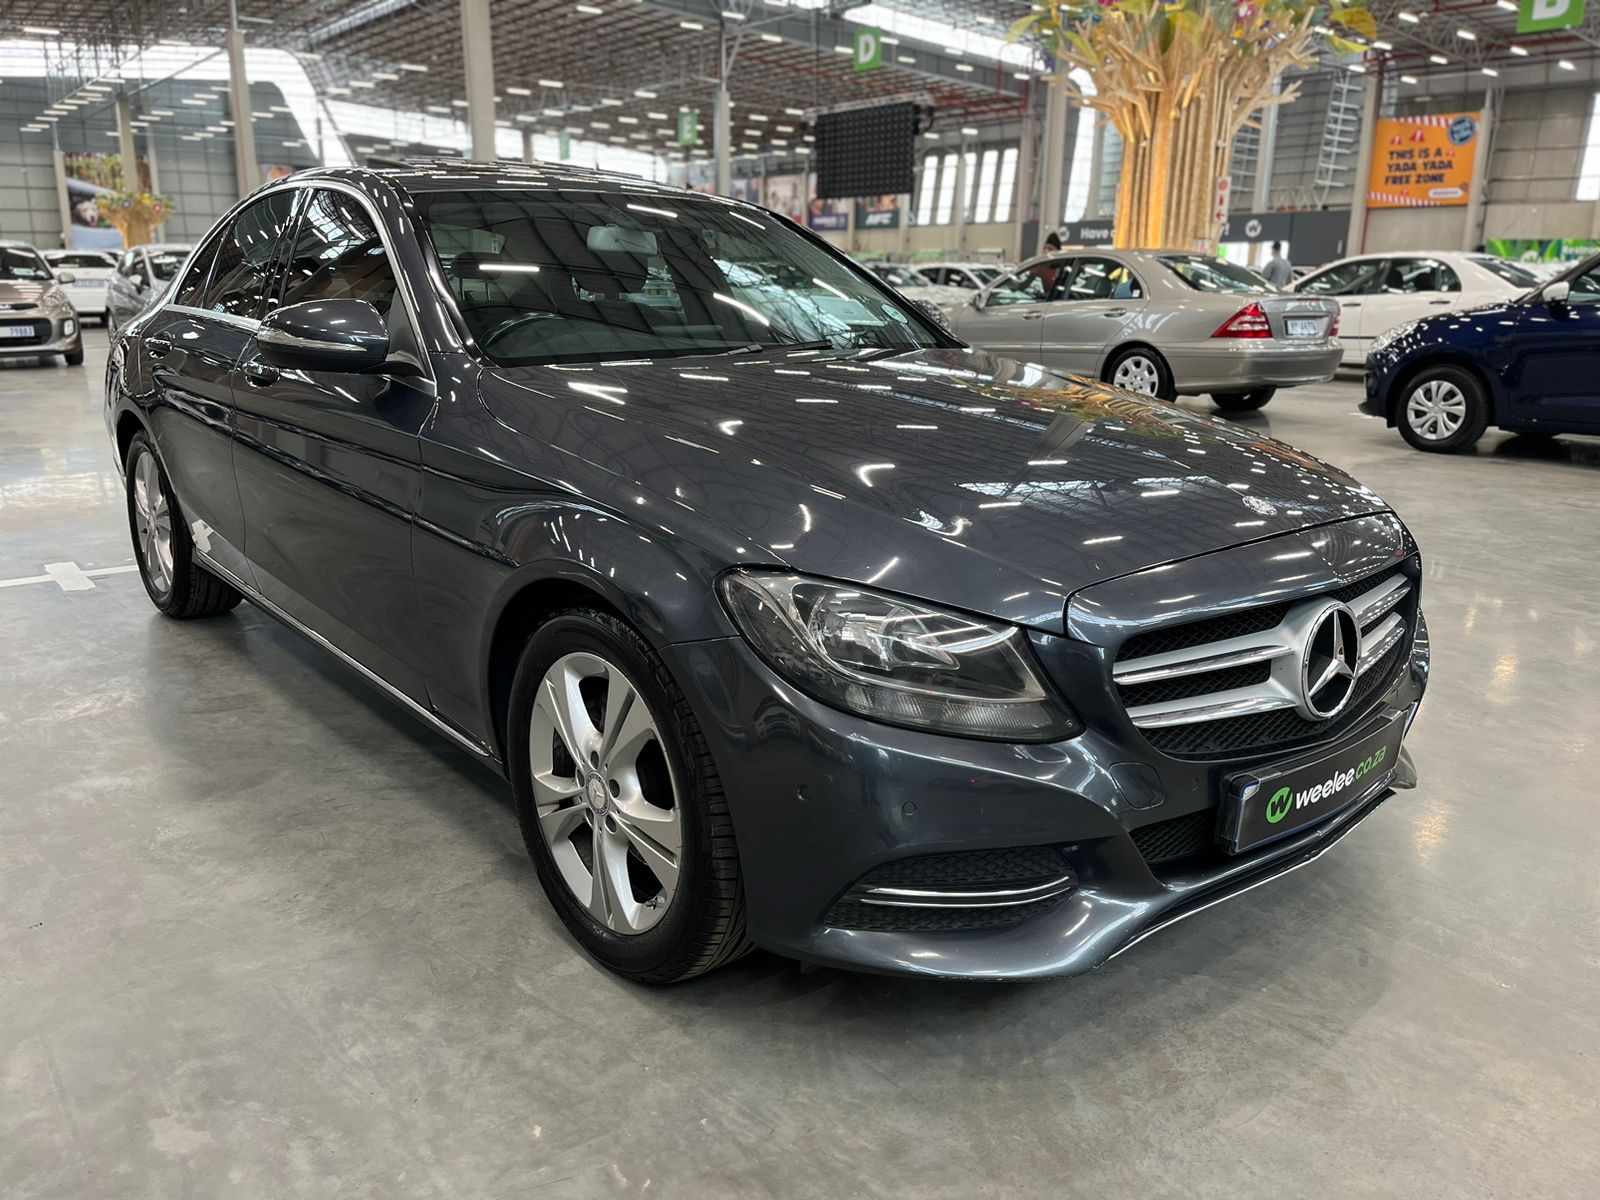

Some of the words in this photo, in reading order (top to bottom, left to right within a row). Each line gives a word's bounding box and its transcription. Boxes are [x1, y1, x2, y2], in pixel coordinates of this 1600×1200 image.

[859, 34, 876, 64] D
[1388, 148, 1415, 160] THIS
[1418, 148, 1429, 159] IS
[1434, 147, 1442, 158] A
[1387, 161, 1417, 173] YADA
[1422, 160, 1453, 171] YADA
[1384, 174, 1411, 186] FREE
[1416, 173, 1444, 184] ZONE
[1080, 227, 1108, 240] Have
[1296, 745, 1387, 809] weelee.co.za
